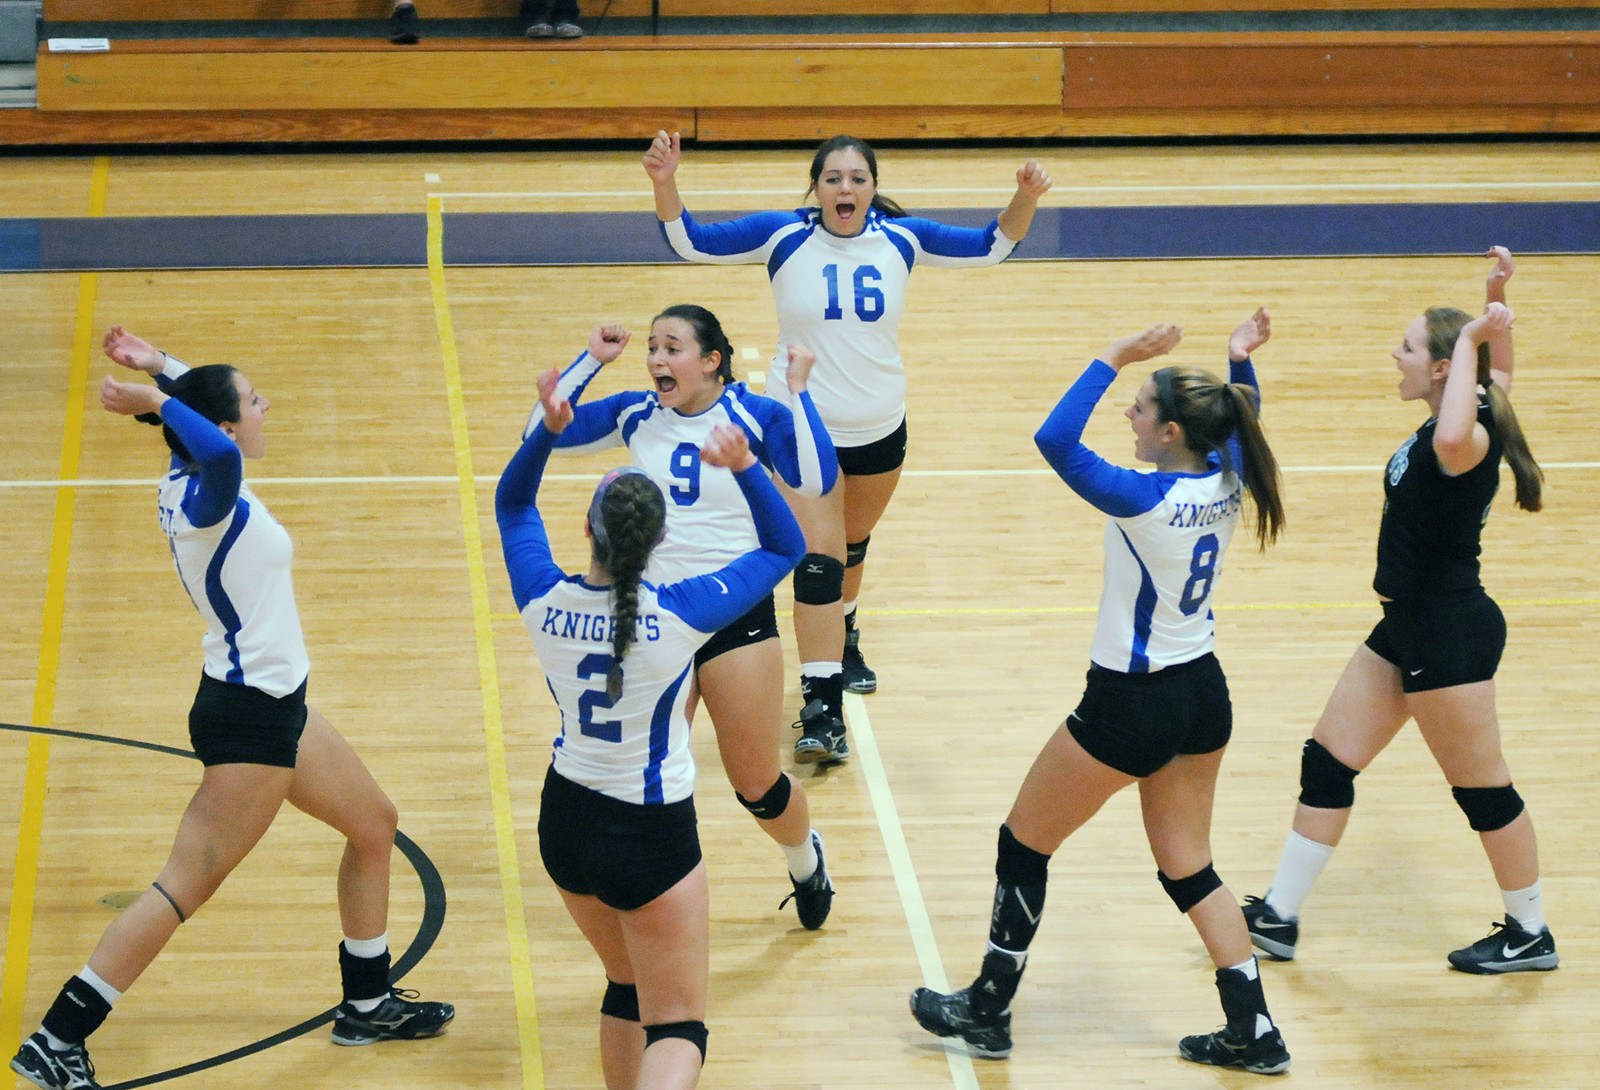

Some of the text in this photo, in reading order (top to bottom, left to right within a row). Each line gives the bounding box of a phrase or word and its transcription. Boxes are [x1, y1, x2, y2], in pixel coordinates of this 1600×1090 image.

[822, 263, 885, 322] 16
[669, 442, 702, 506] 9
[1168, 489, 1240, 528] KNIGH
[1178, 533, 1220, 617] 8
[576, 653, 624, 744] 2
